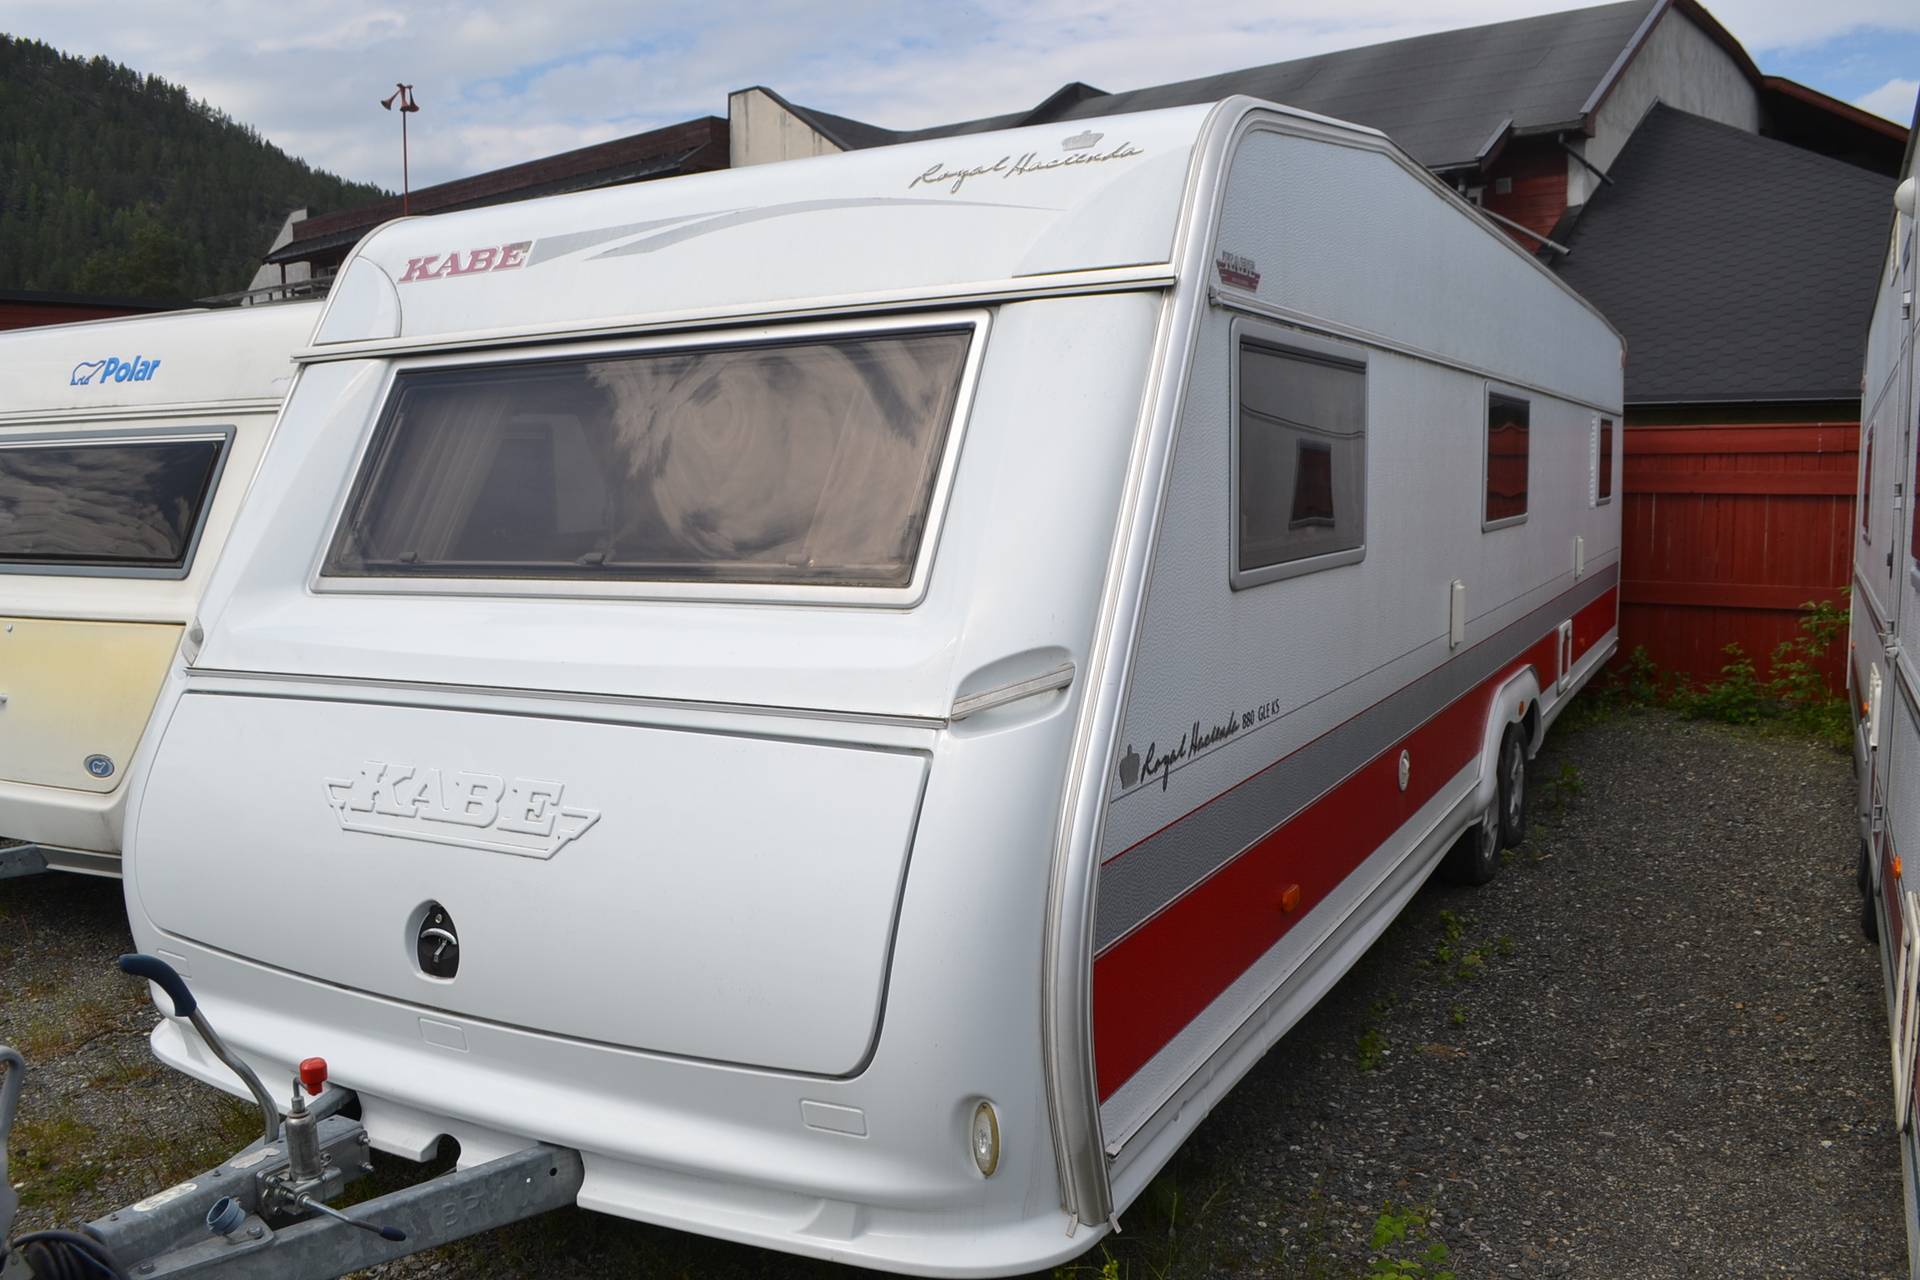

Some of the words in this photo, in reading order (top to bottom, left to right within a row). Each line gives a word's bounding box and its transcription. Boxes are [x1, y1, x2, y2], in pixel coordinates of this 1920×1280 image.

[909, 155, 1010, 194] Royal
[1004, 141, 1144, 179] Hacienda
[396, 240, 532, 284] KABE
[100, 354, 161, 384] Polar
[1140, 733, 1187, 792] Royal
[1188, 711, 1240, 760] Hacienda
[1242, 709, 1254, 729] 880
[1258, 703, 1270, 721] GLE
[1271, 698, 1280, 715] KS
[350, 760, 565, 837] KABE
